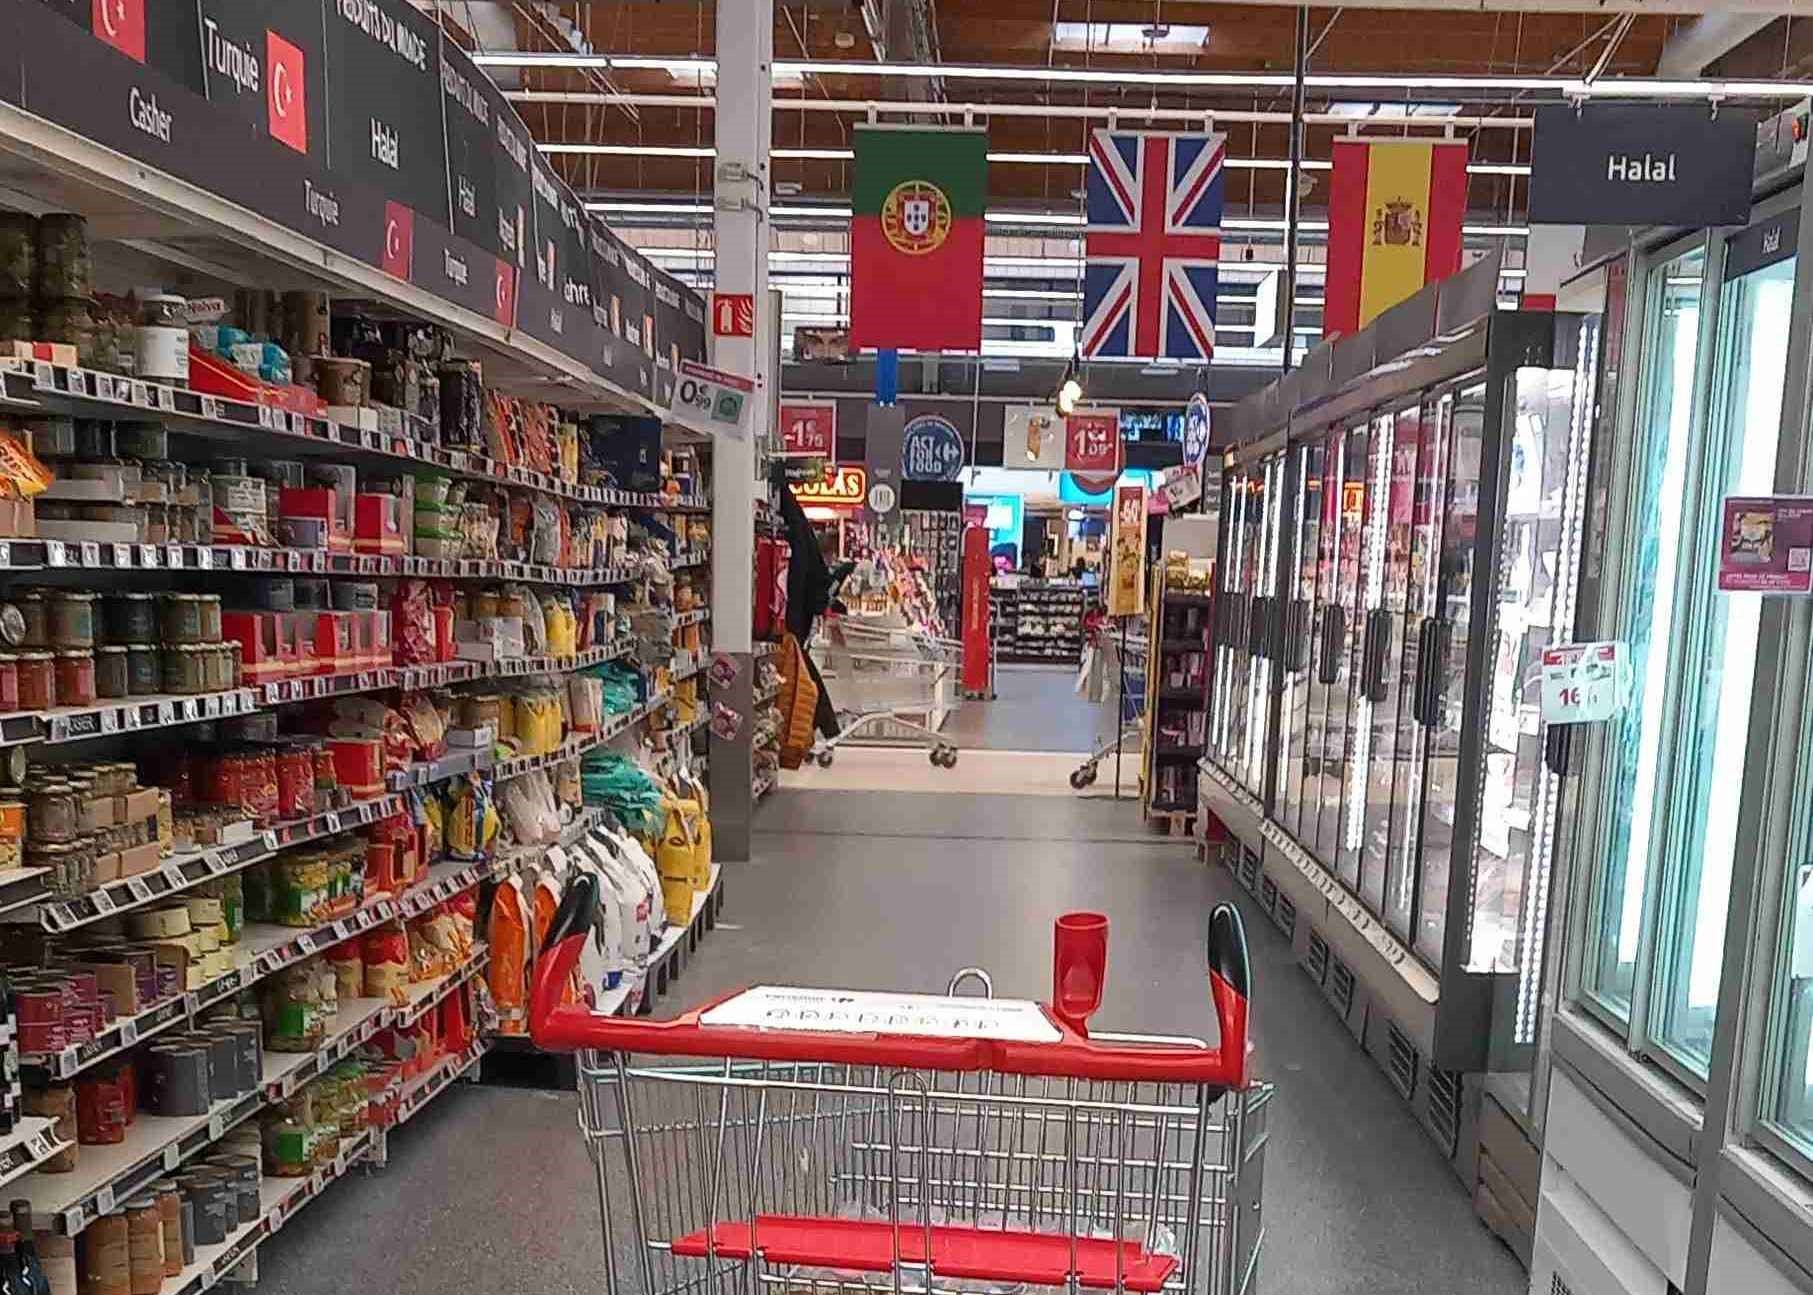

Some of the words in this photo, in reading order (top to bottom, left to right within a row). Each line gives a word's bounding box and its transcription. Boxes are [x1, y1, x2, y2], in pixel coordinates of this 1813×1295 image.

[204, 16, 258, 94] Turquie
[129, 86, 172, 143] Casher
[371, 117, 399, 170] Halal
[1607, 154, 1676, 182] Halal
